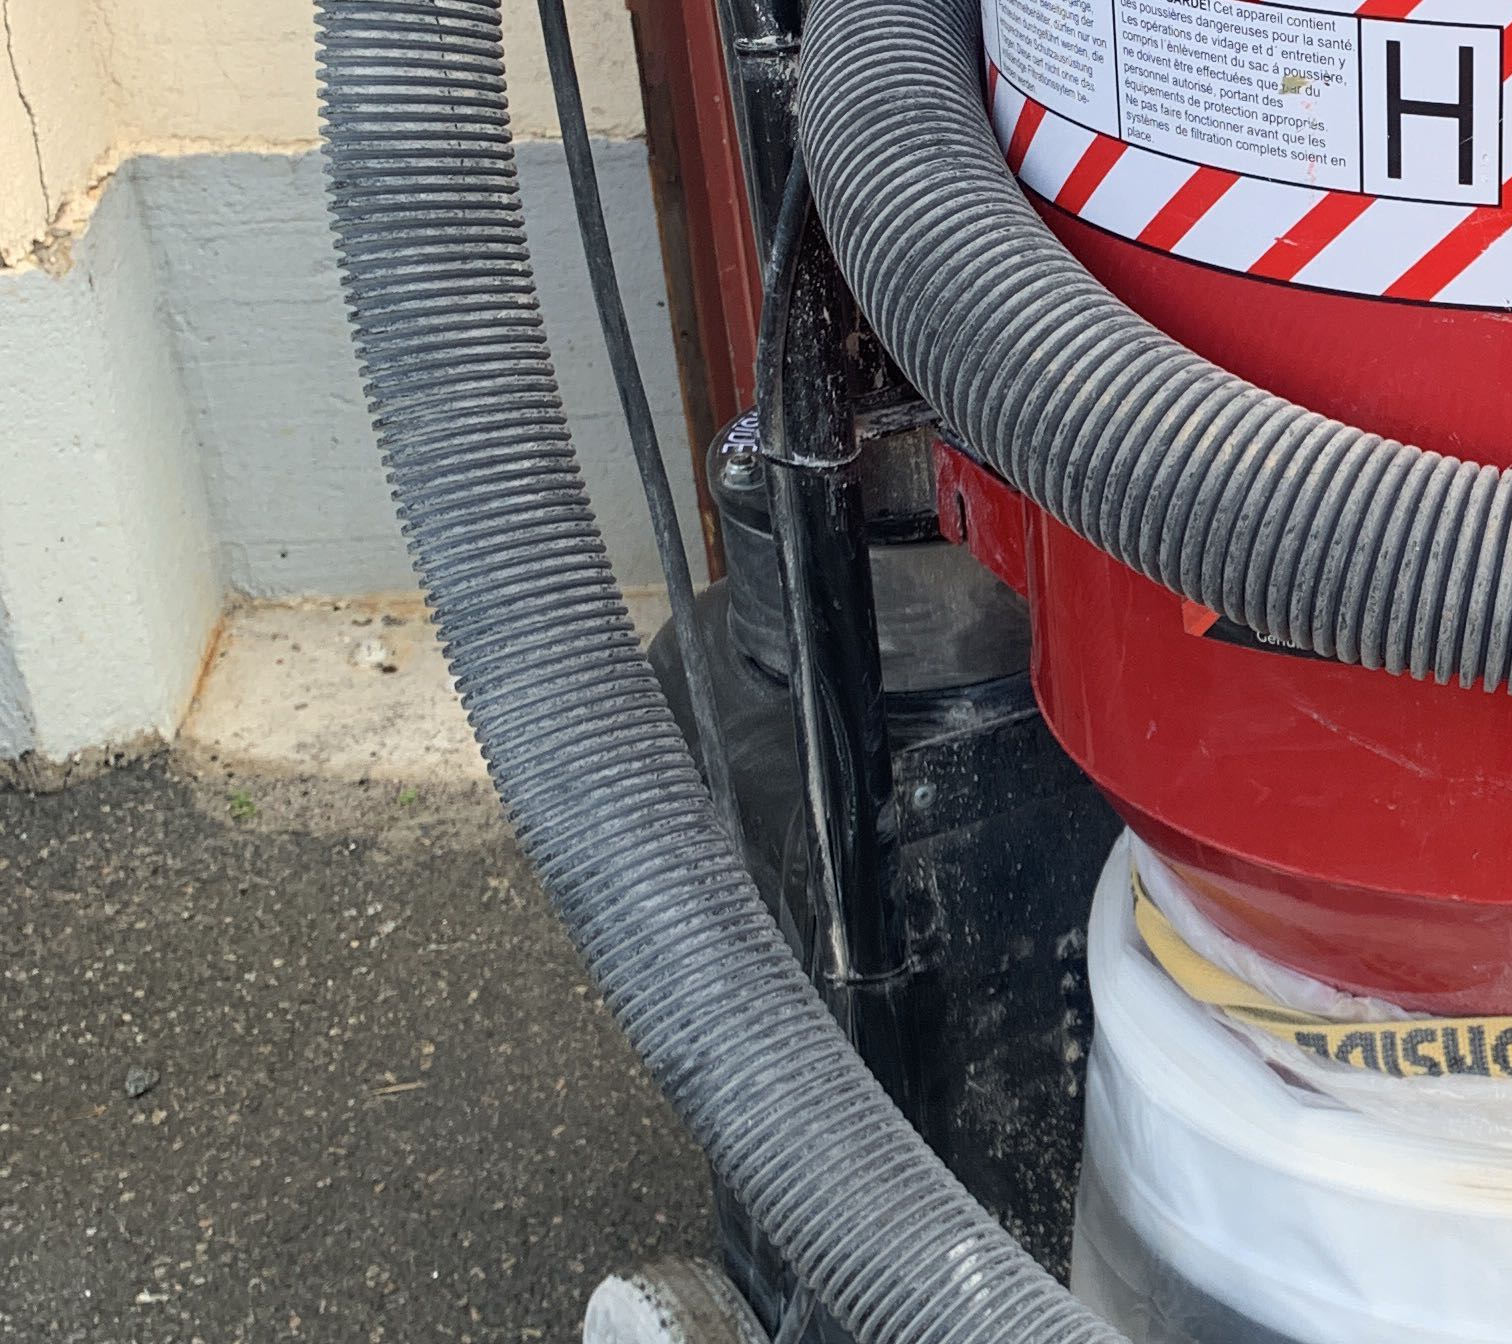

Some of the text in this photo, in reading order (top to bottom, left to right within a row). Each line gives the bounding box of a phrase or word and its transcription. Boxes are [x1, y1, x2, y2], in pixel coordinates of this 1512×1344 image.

[1078, 31, 1091, 42] nur
[1093, 37, 1107, 49] von
[1081, 16, 1094, 28] der
[1122, 12, 1138, 27] Les
[1141, 20, 1192, 41] opérations
[1195, 33, 1208, 44] de
[1211, 35, 1248, 54] vidage
[1252, 45, 1262, 54] et
[1282, 49, 1335, 66] entretien
[1339, 58, 1346, 70] y
[1140, 3, 1193, 24] poussières
[1196, 17, 1269, 39] dangereuses
[1272, 32, 1299, 43] pour
[1303, 34, 1313, 46] la
[1318, 39, 1355, 52] santé.
[1214, 1, 1233, 16] Cet
[1237, 8, 1283, 24] appareil
[1287, 17, 1336, 32] contient
[1123, 31, 1158, 48] compris
[1231, 55, 1245, 68] du
[1249, 61, 1269, 72] sac
[1284, 67, 1347, 86] poussière,
[1123, 47, 1134, 58] ne
[1137, 51, 1171, 68] doivent
[1174, 60, 1193, 73] être
[1196, 66, 1253, 88] effectuées
[1257, 78, 1278, 91] que
[1306, 85, 1320, 97] du
[1124, 63, 1169, 84] personnel
[1219, 87, 1259, 105] portant
[1263, 96, 1284, 108] des
[1125, 79, 1185, 104] équipements
[1188, 96, 1200, 108] de
[1204, 99, 1258, 121] protection
[1126, 93, 1326, 148] Ne pas faire fonctionner avant que les
[1127, 127, 1154, 143] place.
[1386, 40, 1474, 186] H
[1126, 111, 1346, 167] systèmes de filtration complets soient en
